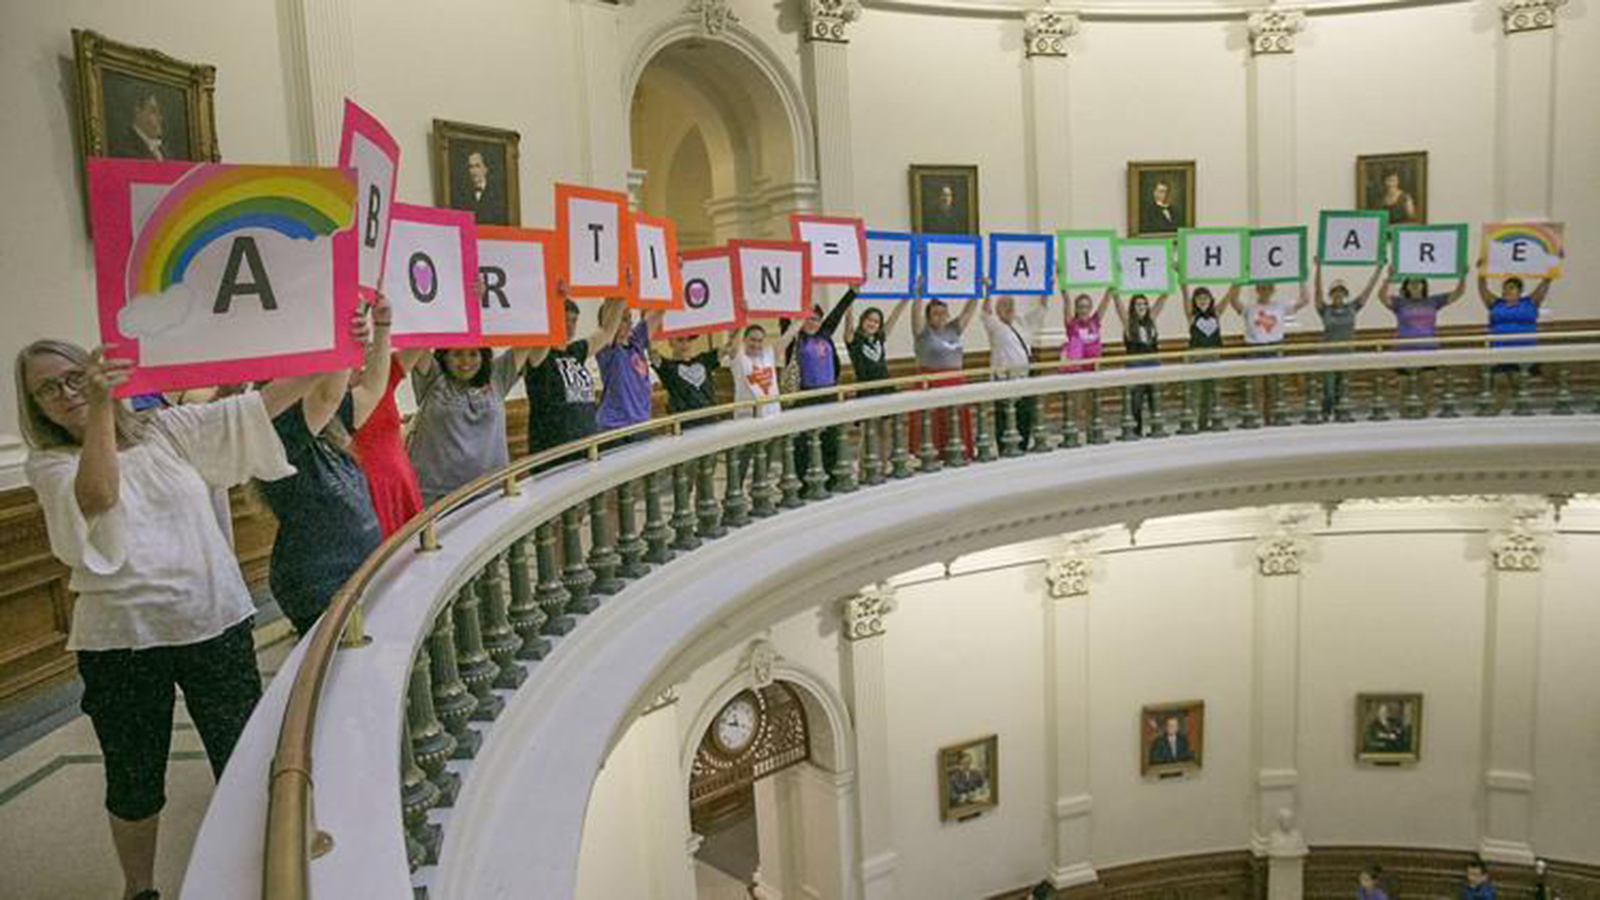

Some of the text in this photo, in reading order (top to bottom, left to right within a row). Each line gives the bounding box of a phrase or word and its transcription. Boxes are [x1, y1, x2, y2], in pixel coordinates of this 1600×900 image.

[364, 185, 380, 247] B
[588, 223, 604, 263] T
[824, 242, 838, 254] =
[1343, 229, 1360, 249] A
[650, 246, 658, 279] I
[1084, 250, 1096, 271] L
[1205, 246, 1221, 266] H
[1268, 246, 1282, 267] C
[1420, 242, 1434, 262] R
[1513, 242, 1526, 261] E
[213, 236, 278, 314] A
[408, 252, 437, 303] O
[878, 255, 893, 279] H
[946, 258, 957, 280] E
[1013, 255, 1030, 278] A
[1135, 257, 1149, 278] T
[479, 267, 510, 308] R
[761, 266, 781, 294] N
[685, 278, 709, 309] O
